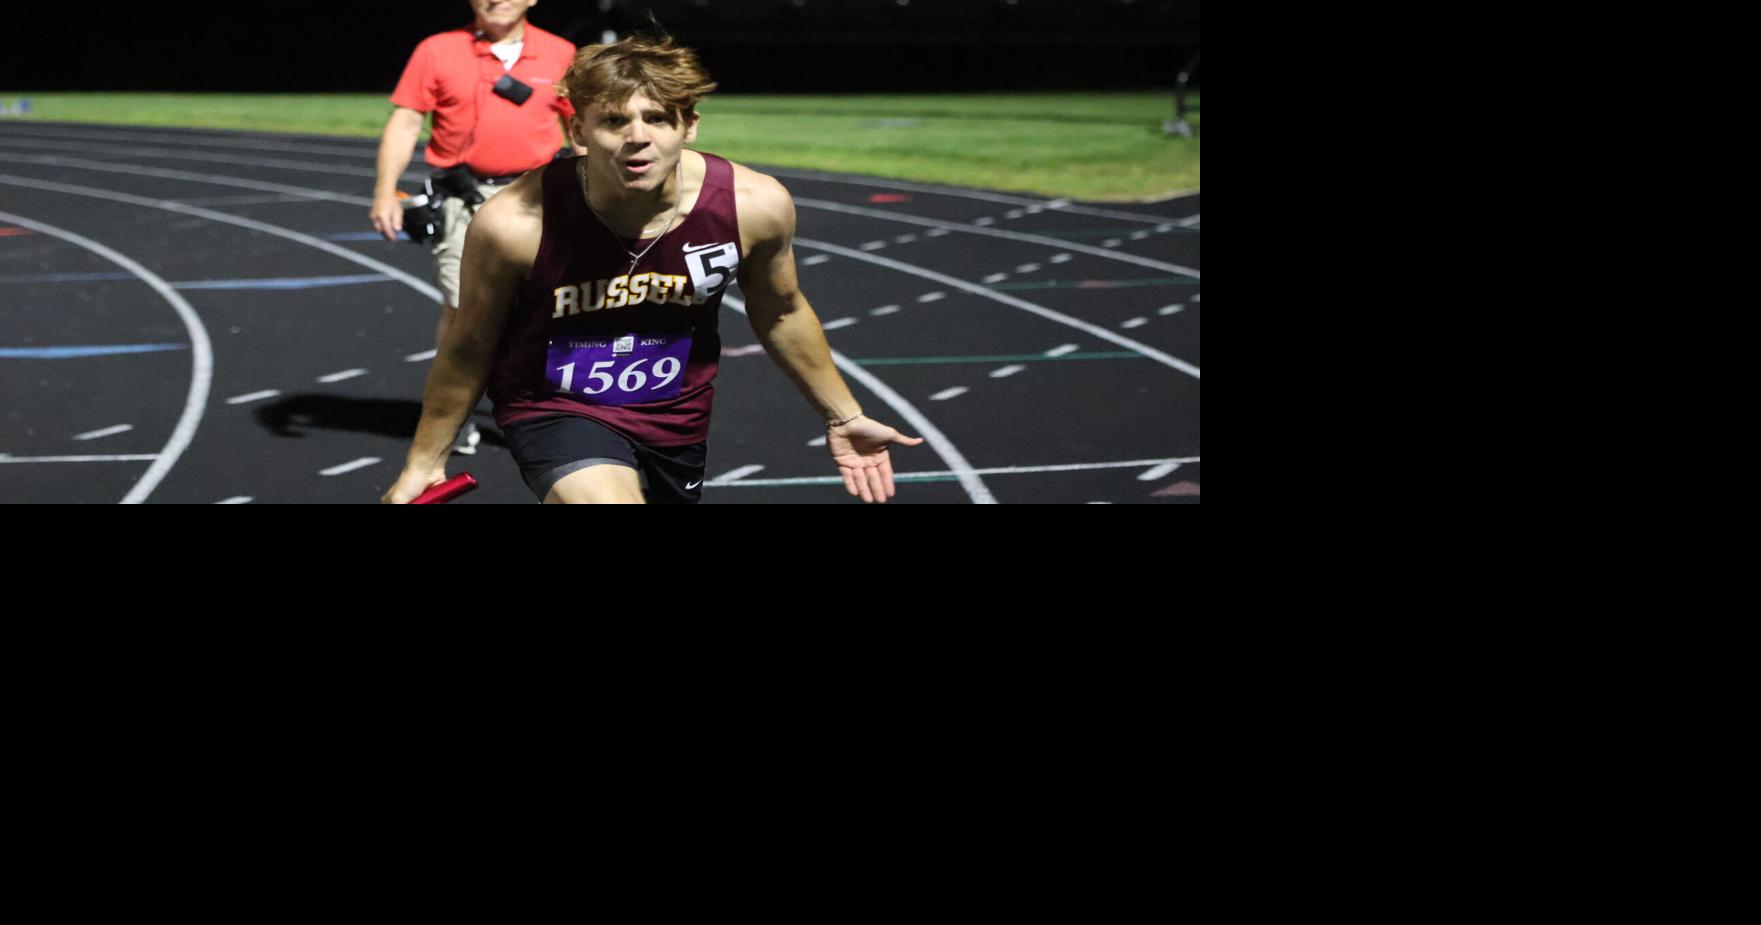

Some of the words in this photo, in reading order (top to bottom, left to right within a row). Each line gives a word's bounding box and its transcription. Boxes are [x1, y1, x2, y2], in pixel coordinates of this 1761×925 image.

[699, 249, 729, 294] 5
[568, 340, 607, 349] TIMING
[640, 338, 667, 347] KING
[556, 357, 681, 395] 1569
